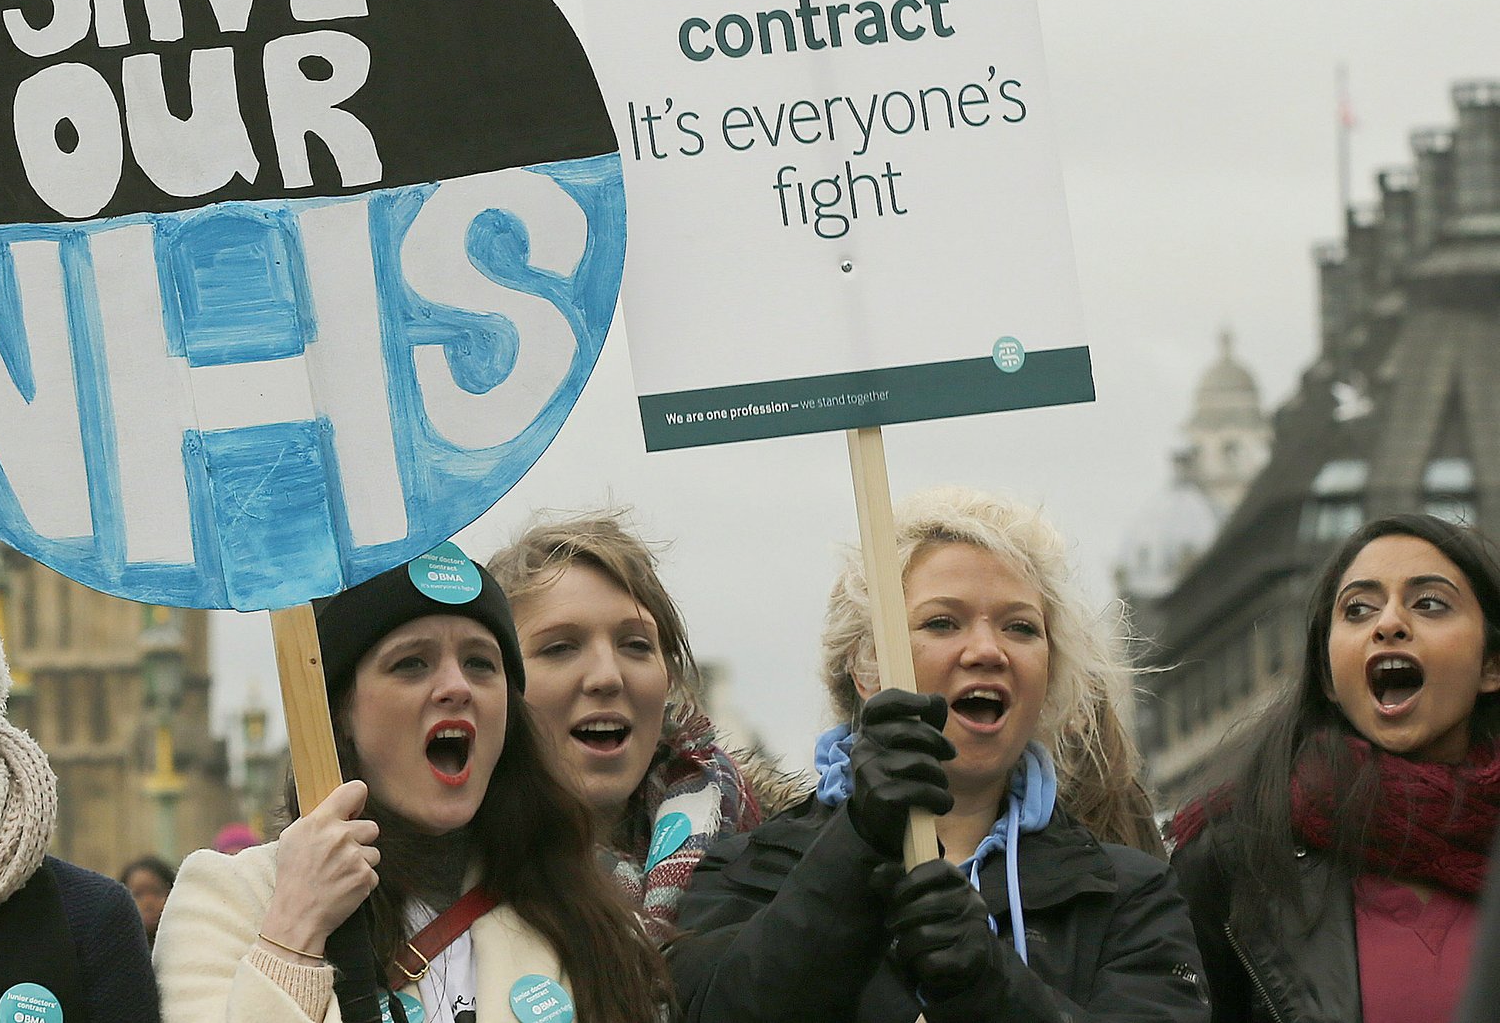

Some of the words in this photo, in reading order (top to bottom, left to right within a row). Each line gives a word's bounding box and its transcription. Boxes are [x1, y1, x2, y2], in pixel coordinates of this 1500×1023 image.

[13, 30, 383, 218] OUR
[627, 97, 706, 161] It's
[721, 65, 1028, 156] everyone's
[772, 160, 908, 240] fight
[666, 413, 683, 425] We
[686, 411, 704, 423] are
[706, 409, 728, 421] one
[730, 401, 790, 420] profession
[800, 399, 816, 410] we
[817, 392, 846, 408] stand
[847, 390, 890, 406] together
[439, 573, 464, 582] BMA
[17, 1002, 47, 1013] contract
[539, 997, 559, 1011] BMA
[24, 1014, 46, 1023] BMA
